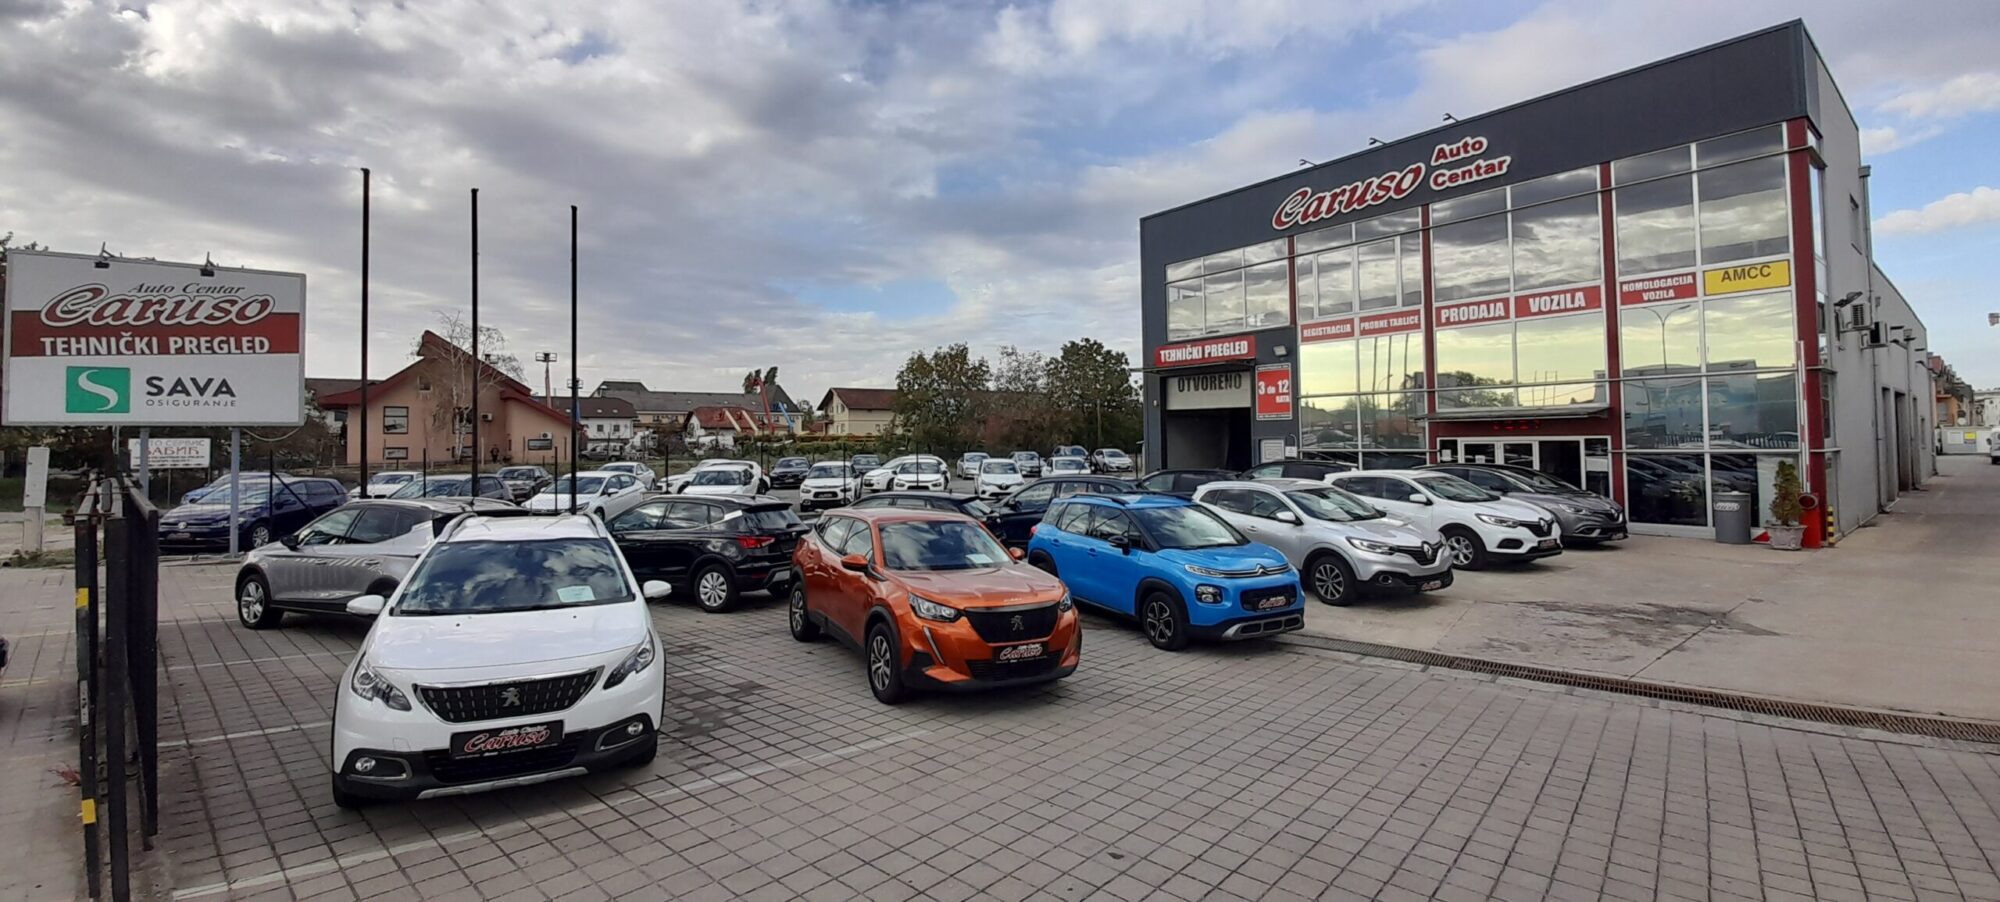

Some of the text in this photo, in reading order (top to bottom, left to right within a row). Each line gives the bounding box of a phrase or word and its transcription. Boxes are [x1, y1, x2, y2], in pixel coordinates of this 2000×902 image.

[1430, 136, 1489, 166] Auto
[1430, 156, 1511, 191] Centar
[1272, 162, 1425, 230] Caruso
[1720, 264, 1772, 283] AMCC
[128, 282, 246, 295] Auto Centar
[1622, 275, 1694, 293] HOMOLOGACIJA
[40, 283, 276, 327] Caruso
[1642, 289, 1675, 301] VOZILA
[1440, 291, 1586, 324] PRODAJA VOZILA
[1302, 323, 1352, 337] REGISTRACIJA
[1360, 314, 1419, 331] PROBNE TABLICE
[40, 331, 270, 356] TEHNIČKI PREGLED
[1159, 341, 1248, 362] TEHNIČKI PREGLED
[145, 376, 236, 397] SAVA
[1178, 373, 1242, 393] OTVORENO
[1258, 380, 1289, 395] 3 do 12
[145, 399, 237, 407] OSIGURANJE
[464, 729, 550, 752] Caruso
